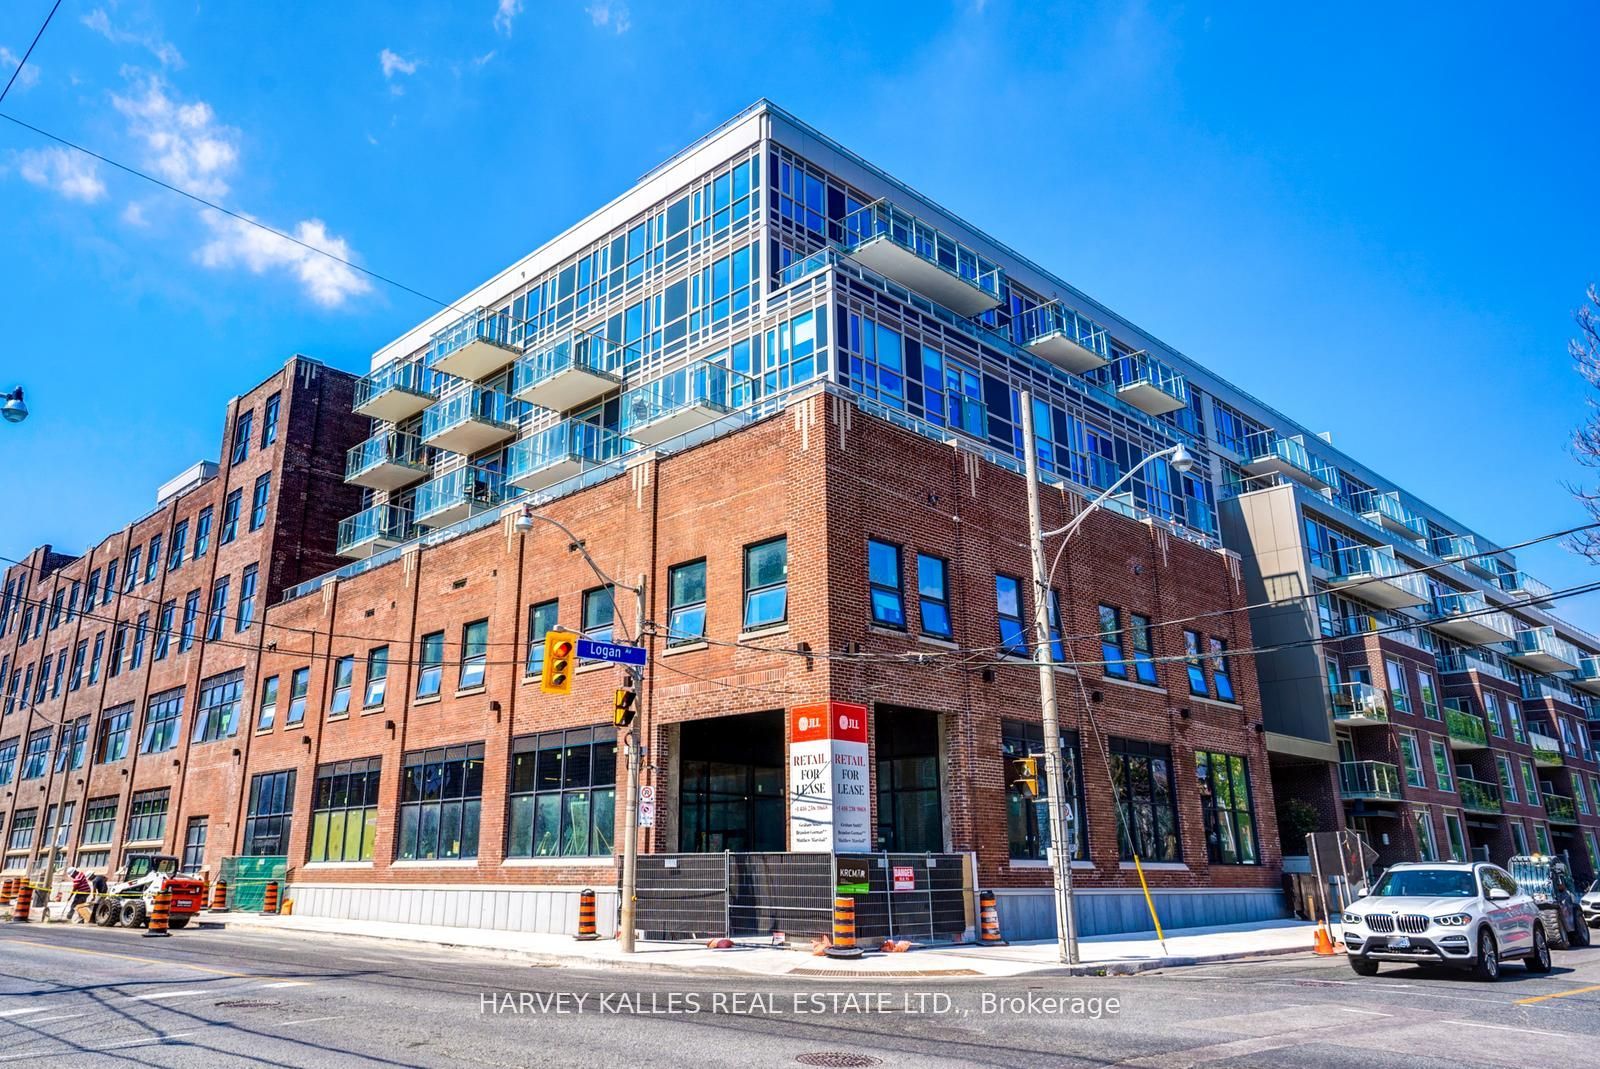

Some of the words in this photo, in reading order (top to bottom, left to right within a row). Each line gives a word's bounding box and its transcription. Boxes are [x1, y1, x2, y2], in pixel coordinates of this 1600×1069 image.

[590, 643, 621, 659] Logan
[808, 717, 821, 728] JLL
[848, 718, 860, 730] JLL
[793, 753, 827, 766] RETAIL
[835, 753, 866, 767] RETAIL
[801, 769, 820, 780] FOR
[842, 769, 859, 780] FOR
[796, 783, 826, 796] LEASE
[838, 784, 865, 796] LEASE
